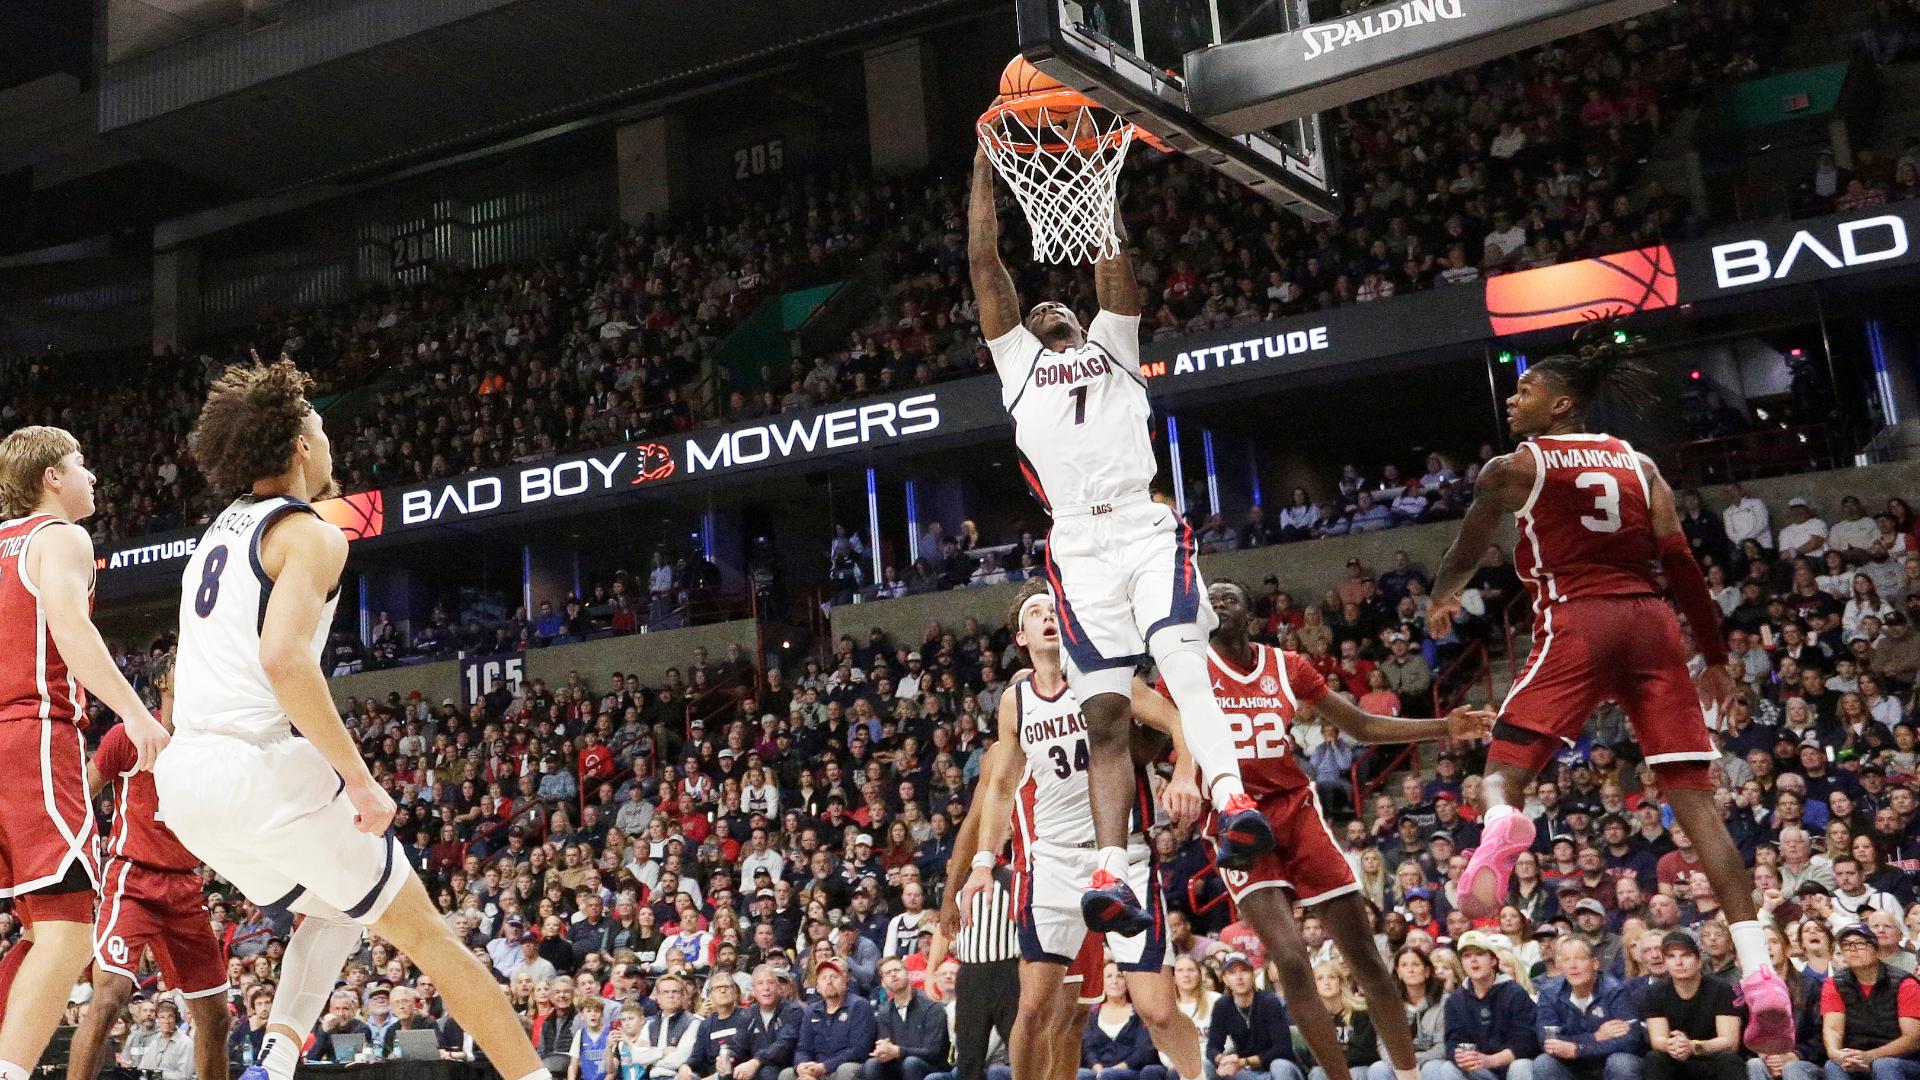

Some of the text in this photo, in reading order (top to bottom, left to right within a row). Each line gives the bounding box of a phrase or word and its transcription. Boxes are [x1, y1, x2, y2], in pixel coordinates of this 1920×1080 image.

[1302, 0, 1462, 61] SPALDING
[735, 140, 783, 180] 205
[1711, 215, 1909, 289] BAD
[1174, 327, 1329, 375] ATTITUDE
[1068, 385, 1088, 425] 1
[402, 393, 940, 524] BAD BOY MOWERS
[1543, 449, 1635, 470] NWANKWO
[1091, 504, 1112, 515] ZAGS
[1575, 472, 1621, 533] 3
[110, 538, 197, 569] ATTITUDE
[195, 544, 228, 619] 8
[1226, 712, 1285, 759] 22
[1048, 738, 1090, 780] 34
[107, 935, 129, 964] OU
